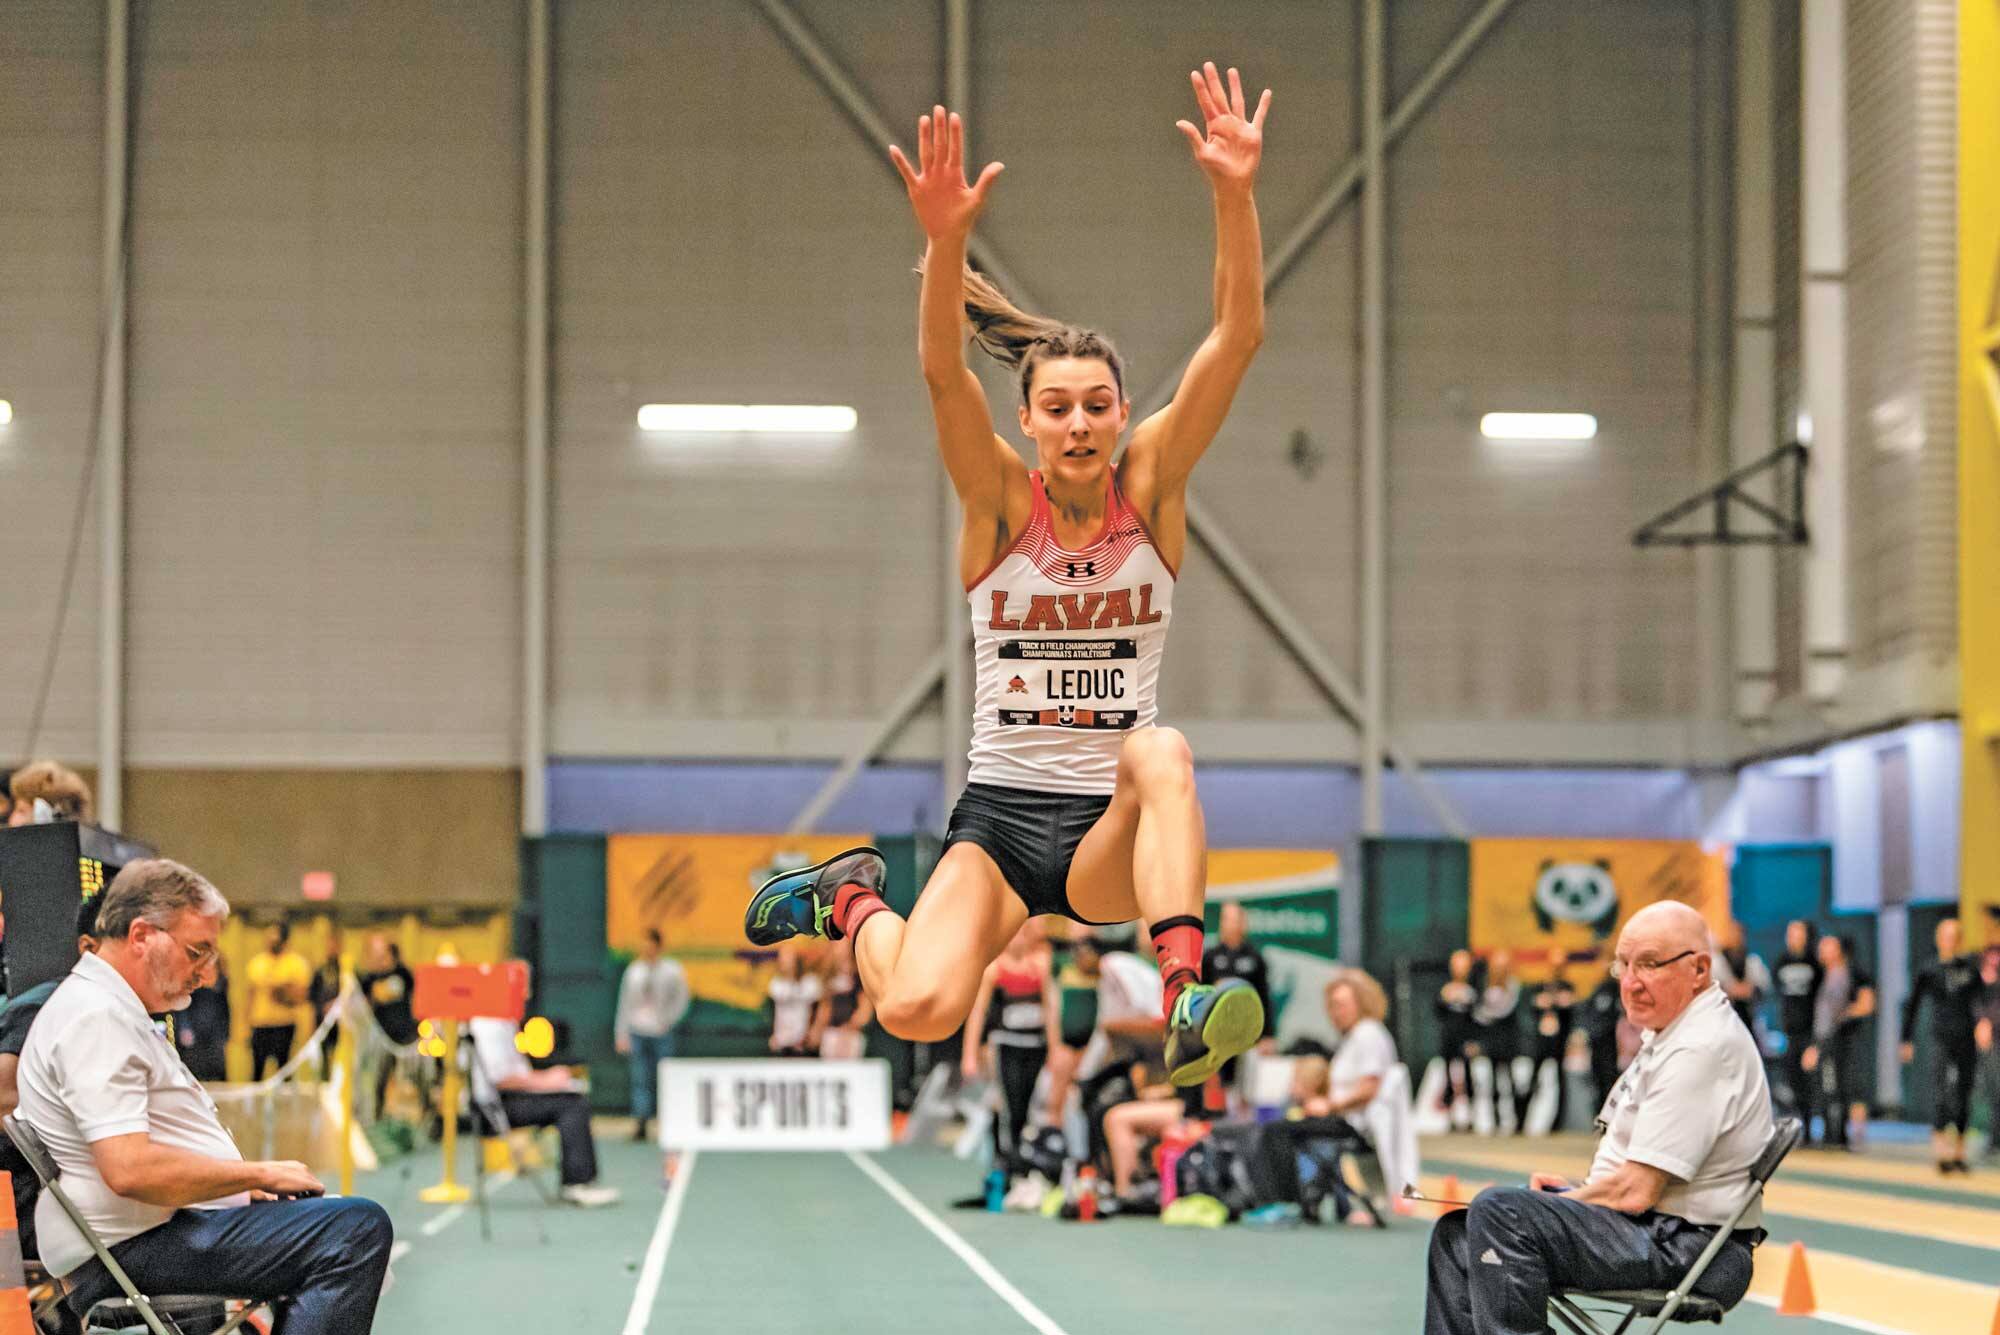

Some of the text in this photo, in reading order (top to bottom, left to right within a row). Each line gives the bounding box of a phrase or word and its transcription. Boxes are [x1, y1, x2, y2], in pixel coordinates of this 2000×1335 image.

[988, 583, 1162, 631] LAVAL
[1018, 642, 1039, 650] TRACK
[1046, 642, 1064, 650] FIELD
[1065, 642, 1116, 650] CHAMPIONSHIPS
[1022, 650, 1072, 658] CHAMPIONNATS
[1046, 668, 1125, 700] LEDUC
